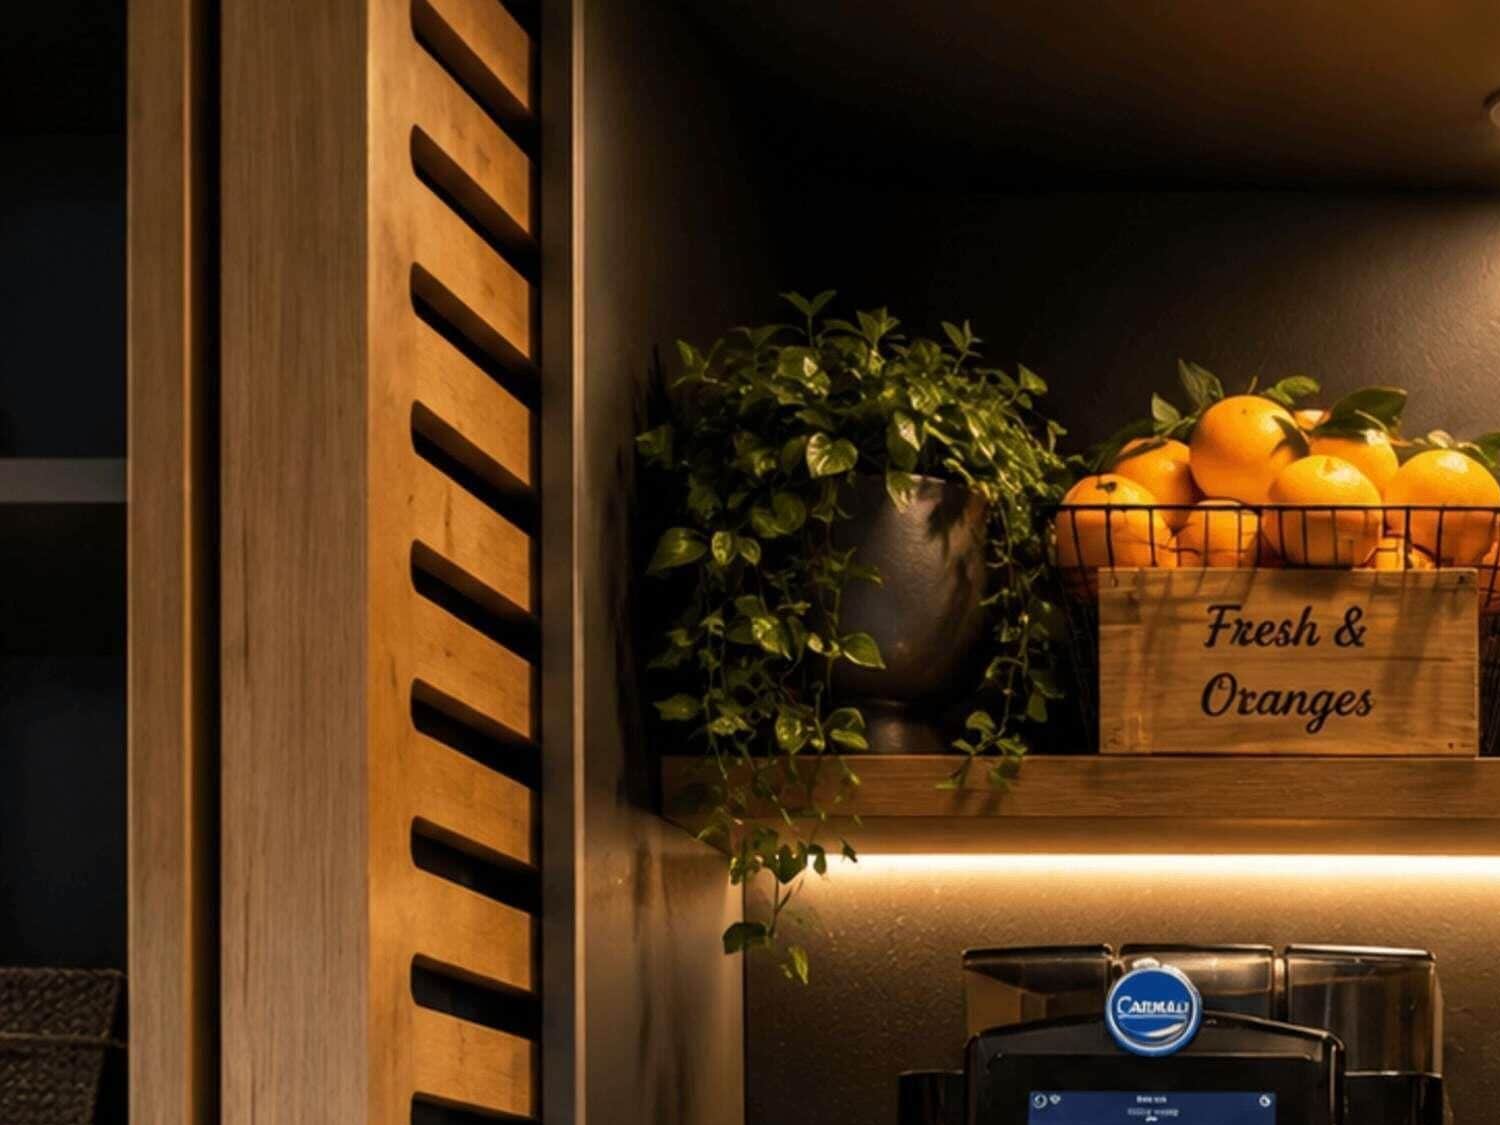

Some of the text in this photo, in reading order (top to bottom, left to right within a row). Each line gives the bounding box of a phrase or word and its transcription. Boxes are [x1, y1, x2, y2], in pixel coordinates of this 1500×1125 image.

[1203, 604, 1367, 648] Fresh &
[1201, 672, 1374, 734] Oranges
